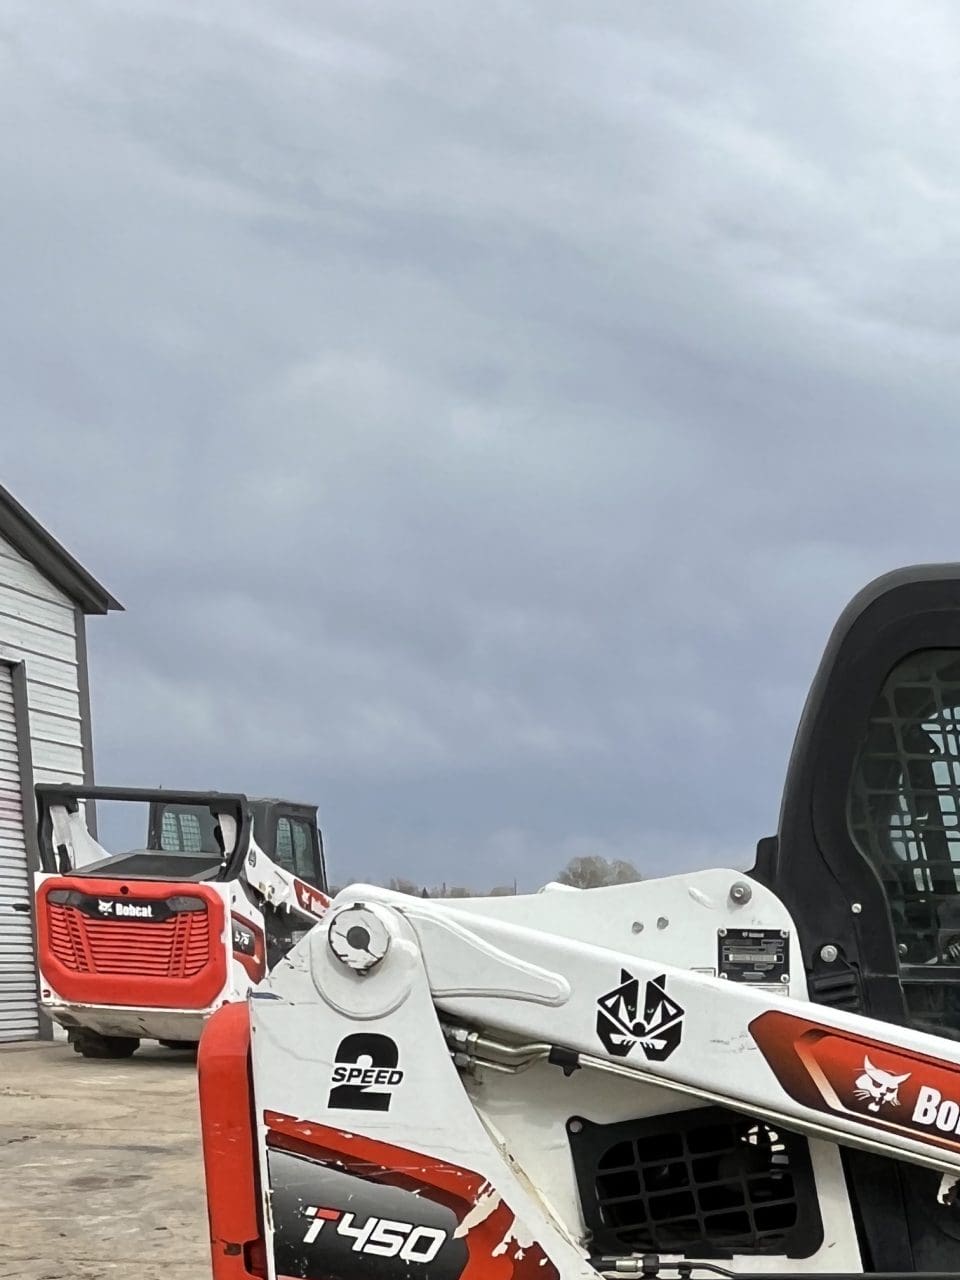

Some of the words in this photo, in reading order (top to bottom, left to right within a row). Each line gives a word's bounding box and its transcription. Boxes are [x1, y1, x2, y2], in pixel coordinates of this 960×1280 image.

[115, 902, 153, 918] Bobcat
[327, 1032, 399, 1112] 2
[331, 1066, 404, 1086] SPEED
[303, 1206, 447, 1264] T450
